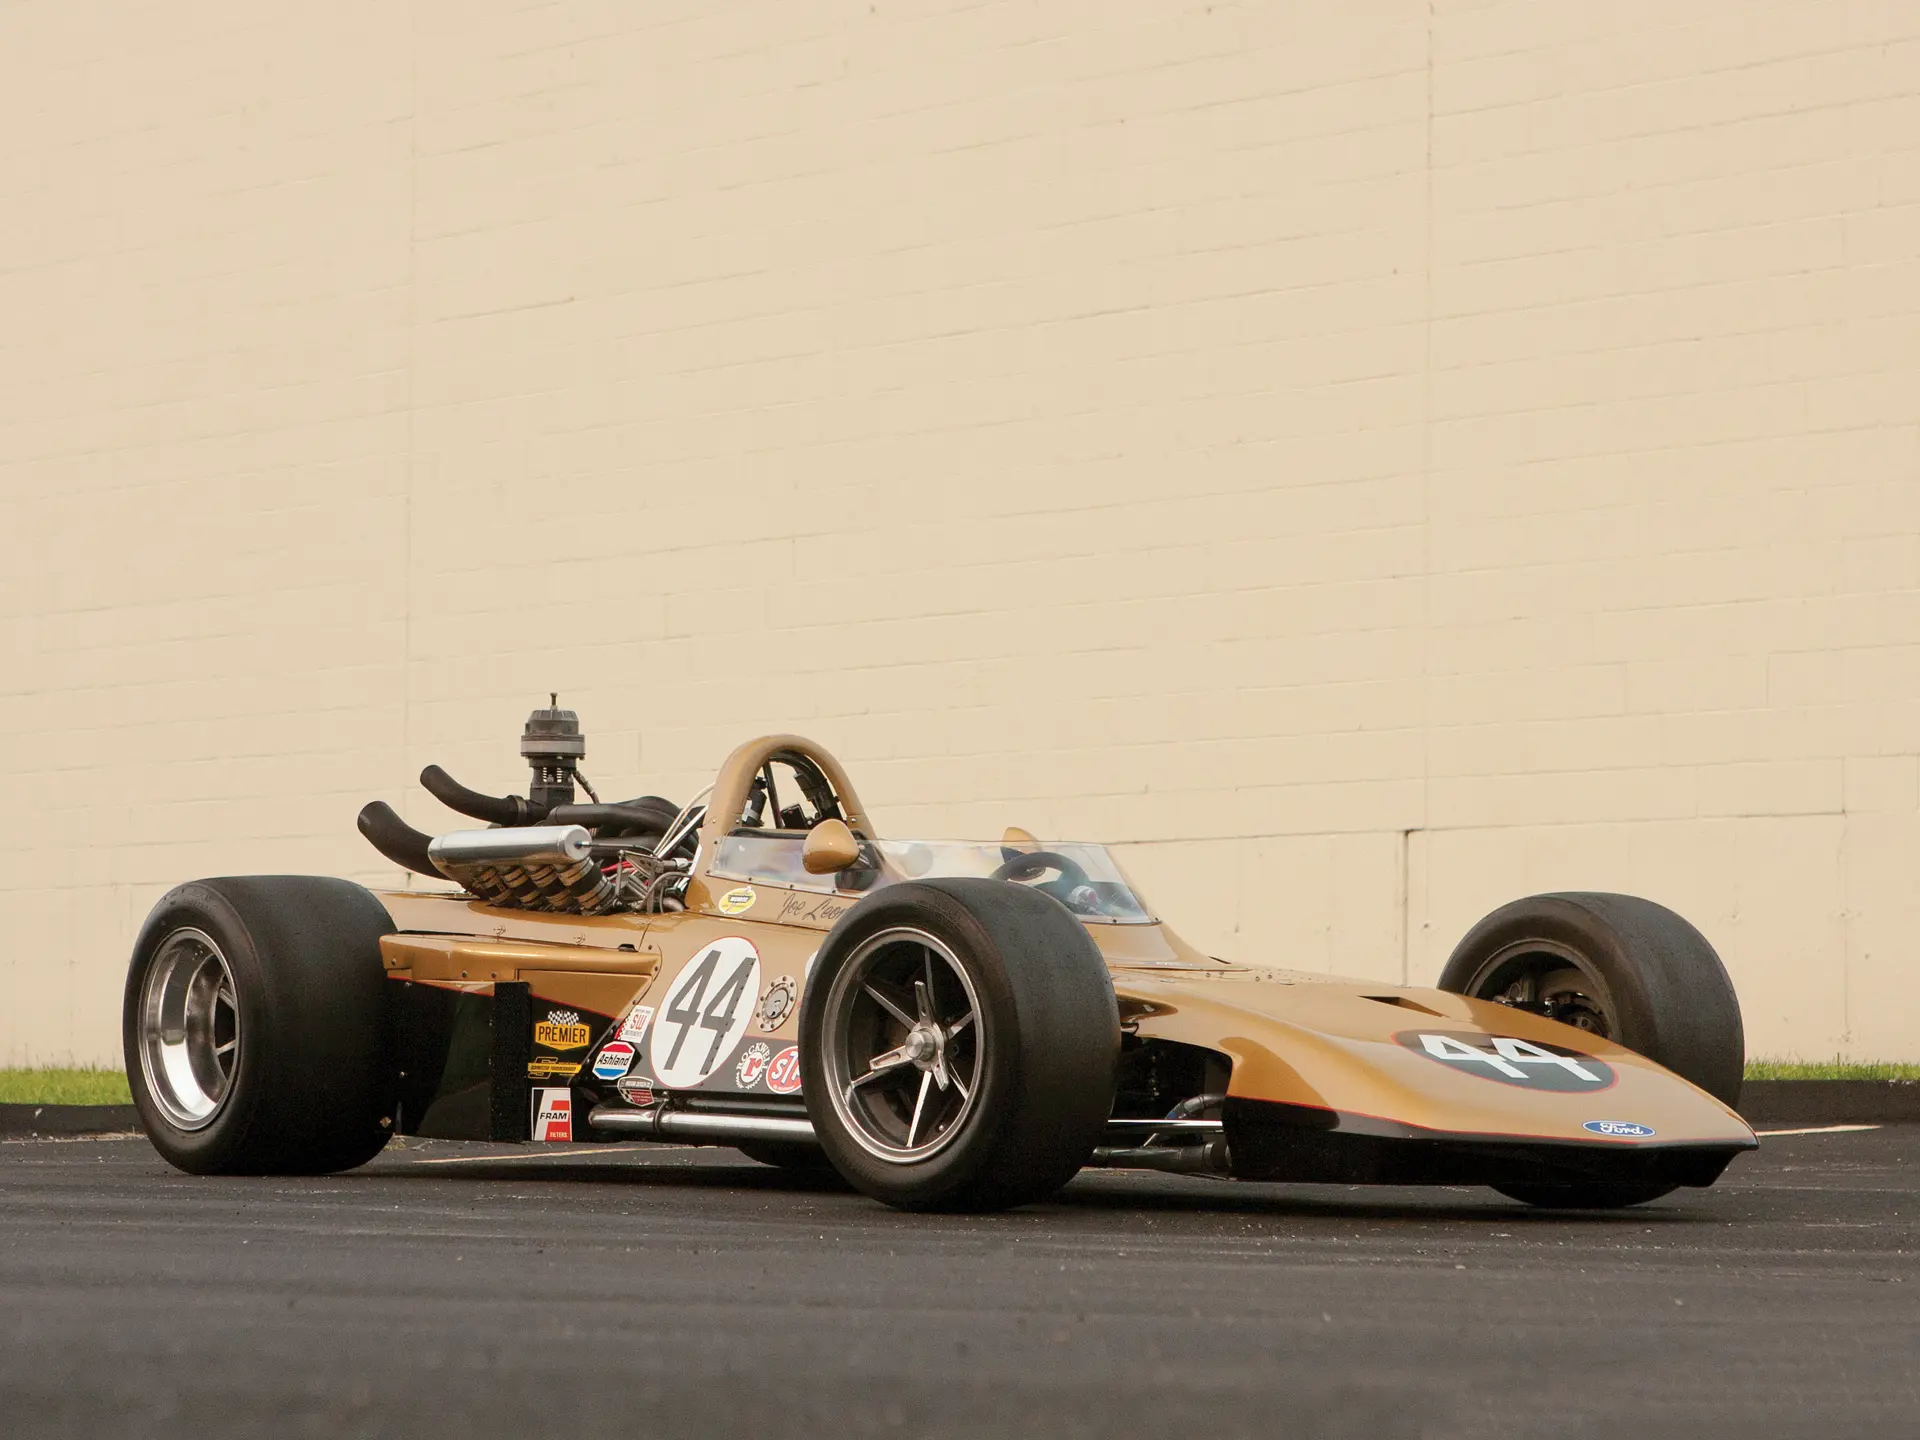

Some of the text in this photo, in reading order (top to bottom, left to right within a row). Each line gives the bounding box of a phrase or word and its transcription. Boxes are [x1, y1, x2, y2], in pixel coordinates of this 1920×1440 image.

[777, 891, 806, 921] Joe
[663, 949, 757, 1076] 44
[630, 1013, 648, 1031] SW
[538, 1026, 587, 1043] PREMIER
[597, 1053, 631, 1066] Ashland
[736, 1042, 770, 1070] ROCKWELL
[1417, 1034, 1602, 1082] 44
[540, 1112, 567, 1120] FRAM
[1600, 1122, 1644, 1135] Ford
